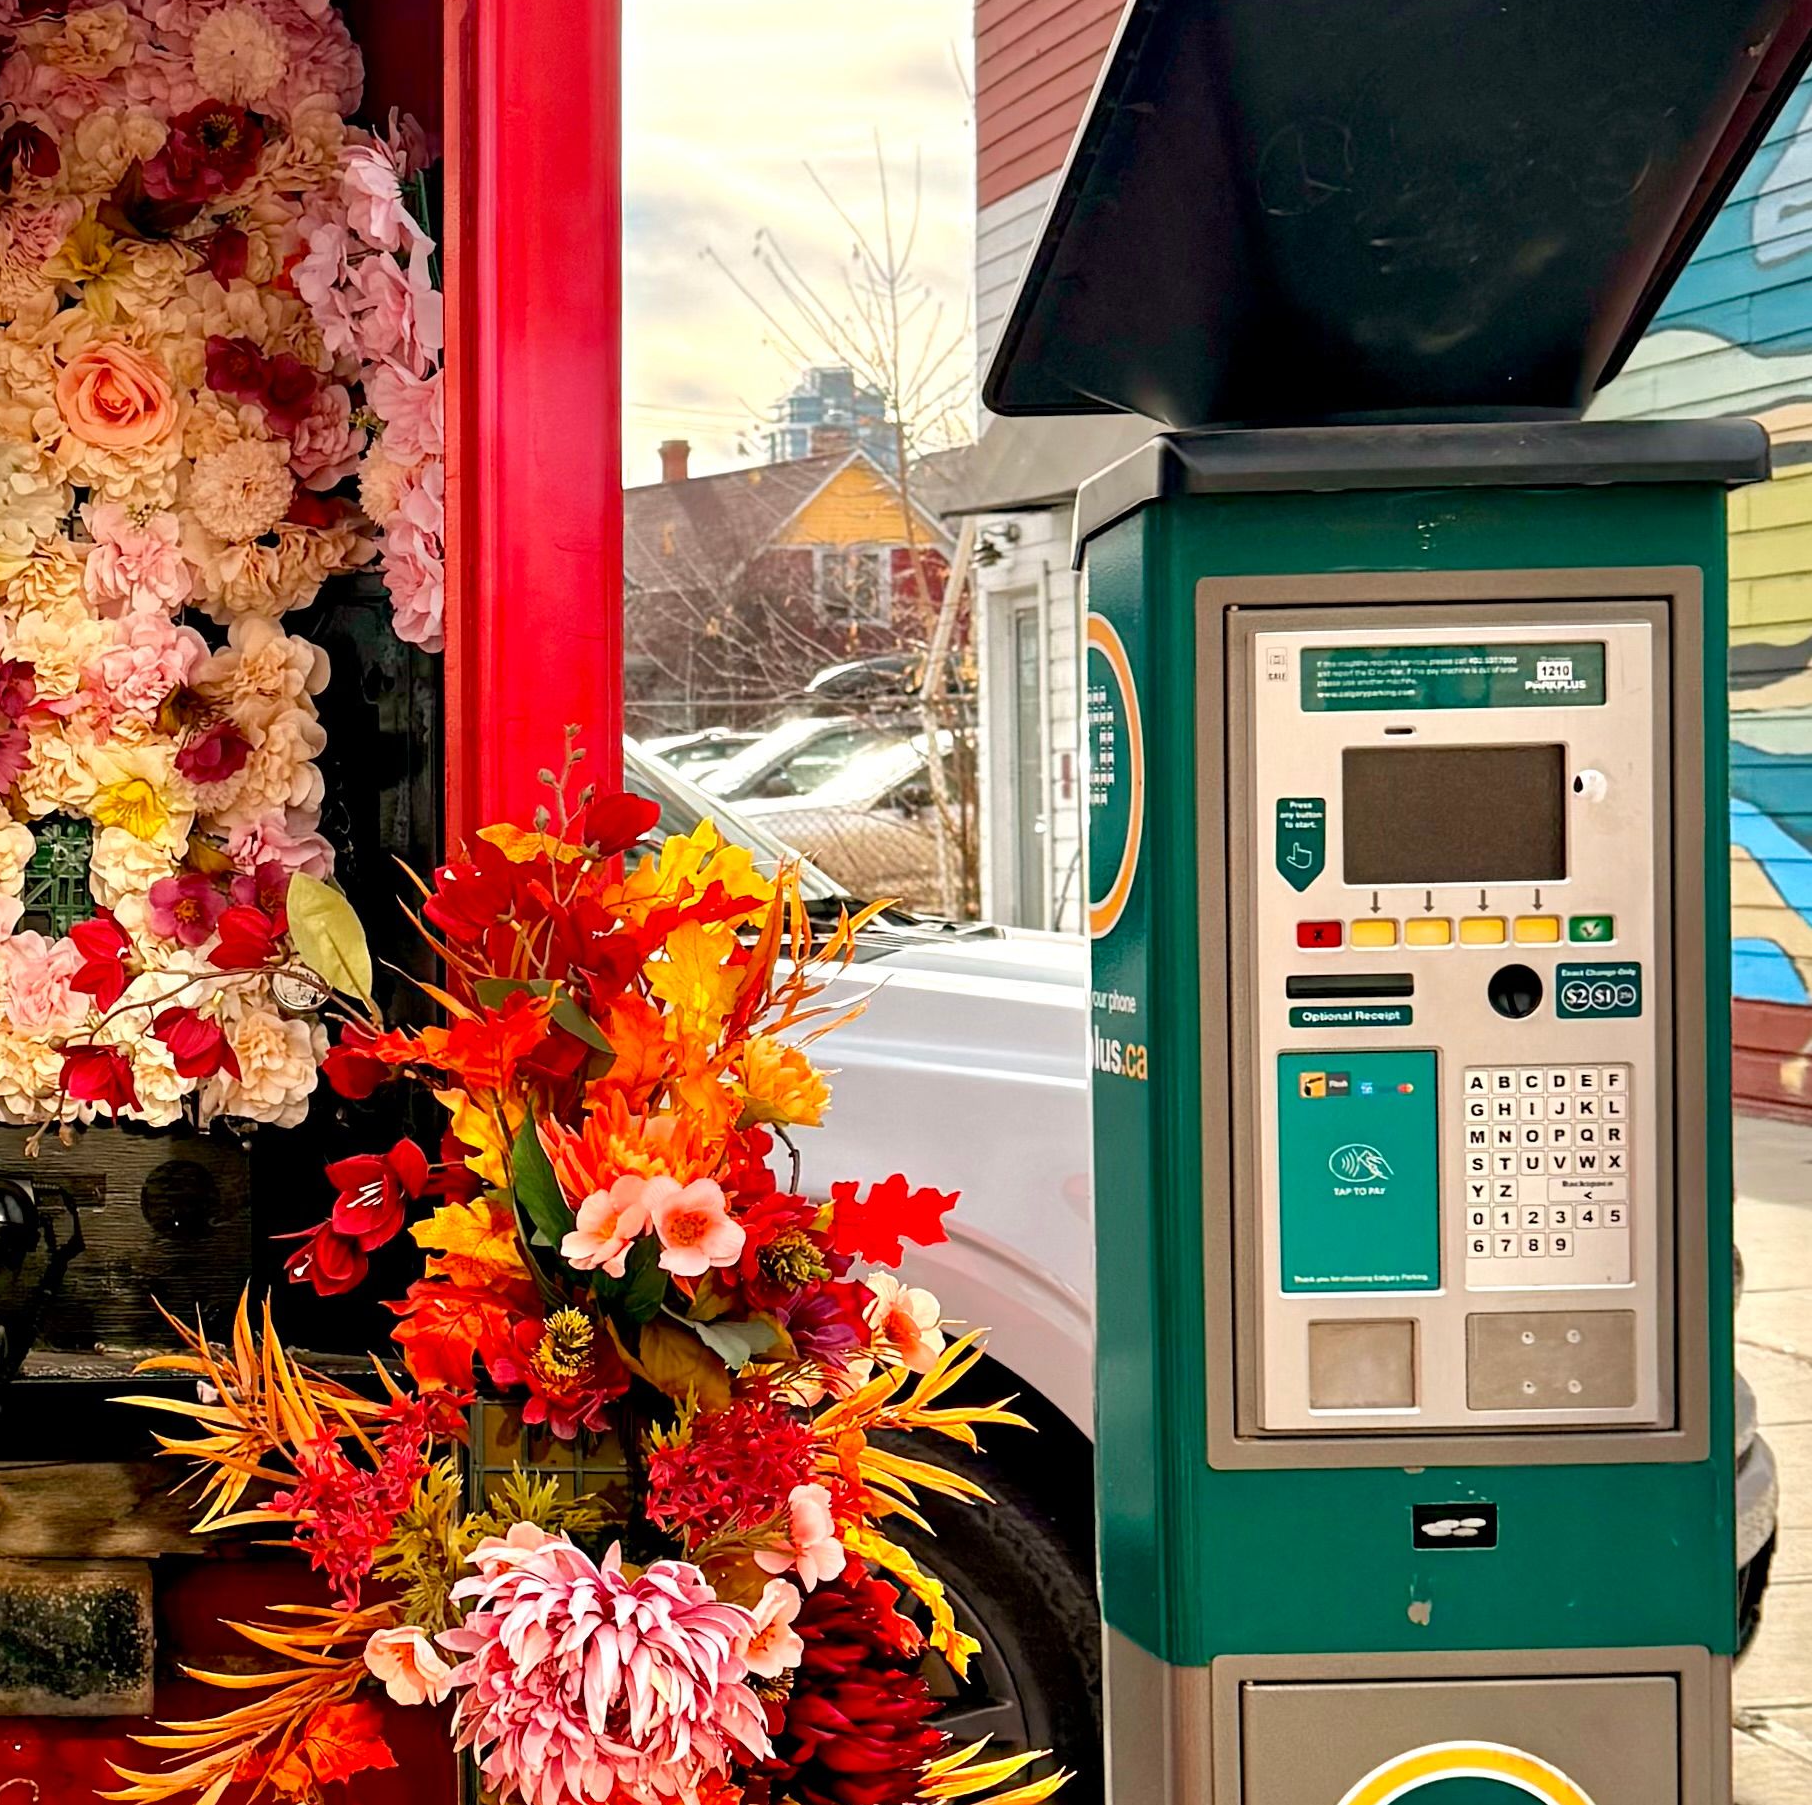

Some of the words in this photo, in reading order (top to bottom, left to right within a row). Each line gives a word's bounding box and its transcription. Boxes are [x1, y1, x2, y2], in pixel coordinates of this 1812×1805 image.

[1541, 665, 1570, 676] 1210
[1279, 812, 1294, 820] any
[1295, 811, 1323, 819] button
[1092, 990, 1107, 1009] our
[1109, 989, 1137, 1014] phone
[1566, 988, 1588, 1005] $2
[1594, 989, 1610, 1004] $1
[1302, 1010, 1353, 1023] Optional
[1355, 1009, 1401, 1022] Receipt
[1094, 1024, 1148, 1080] lus.ca
[1470, 1077, 1483, 1089] A
[1499, 1076, 1510, 1088] B
[1526, 1075, 1538, 1088] C
[1554, 1075, 1565, 1087] D
[1581, 1074, 1592, 1087] E
[1609, 1074, 1618, 1086] F
[1471, 1104, 1484, 1116] G
[1499, 1103, 1511, 1116] H
[1530, 1102, 1534, 1115] I
[1555, 1102, 1565, 1115] J
[1580, 1101, 1593, 1114] K
[1609, 1101, 1620, 1114] L
[1470, 1131, 1485, 1143] M
[1499, 1130, 1511, 1143] N
[1526, 1130, 1539, 1142] O
[1555, 1129, 1565, 1142] P
[1581, 1129, 1594, 1142] Q
[1609, 1128, 1620, 1141] R
[1472, 1158, 1483, 1171] S
[1499, 1157, 1511, 1170] T
[1526, 1157, 1539, 1170] U
[1554, 1156, 1566, 1169] V
[1579, 1156, 1595, 1168] W
[1609, 1155, 1620, 1168] X
[1334, 1187, 1352, 1196] TAP
[1354, 1187, 1367, 1195] TO
[1369, 1187, 1386, 1195] PAY
[1472, 1185, 1484, 1197] Y
[1500, 1185, 1512, 1197] Z
[1473, 1213, 1483, 1225] 0
[1501, 1212, 1509, 1224] 1
[1528, 1211, 1539, 1224] 2
[1556, 1211, 1566, 1223] 3
[1582, 1210, 1593, 1222] 4
[1611, 1210, 1620, 1222] 5
[1474, 1240, 1484, 1252] 6
[1501, 1239, 1511, 1252] 7
[1529, 1239, 1538, 1251] 8
[1556, 1238, 1566, 1251] 9
